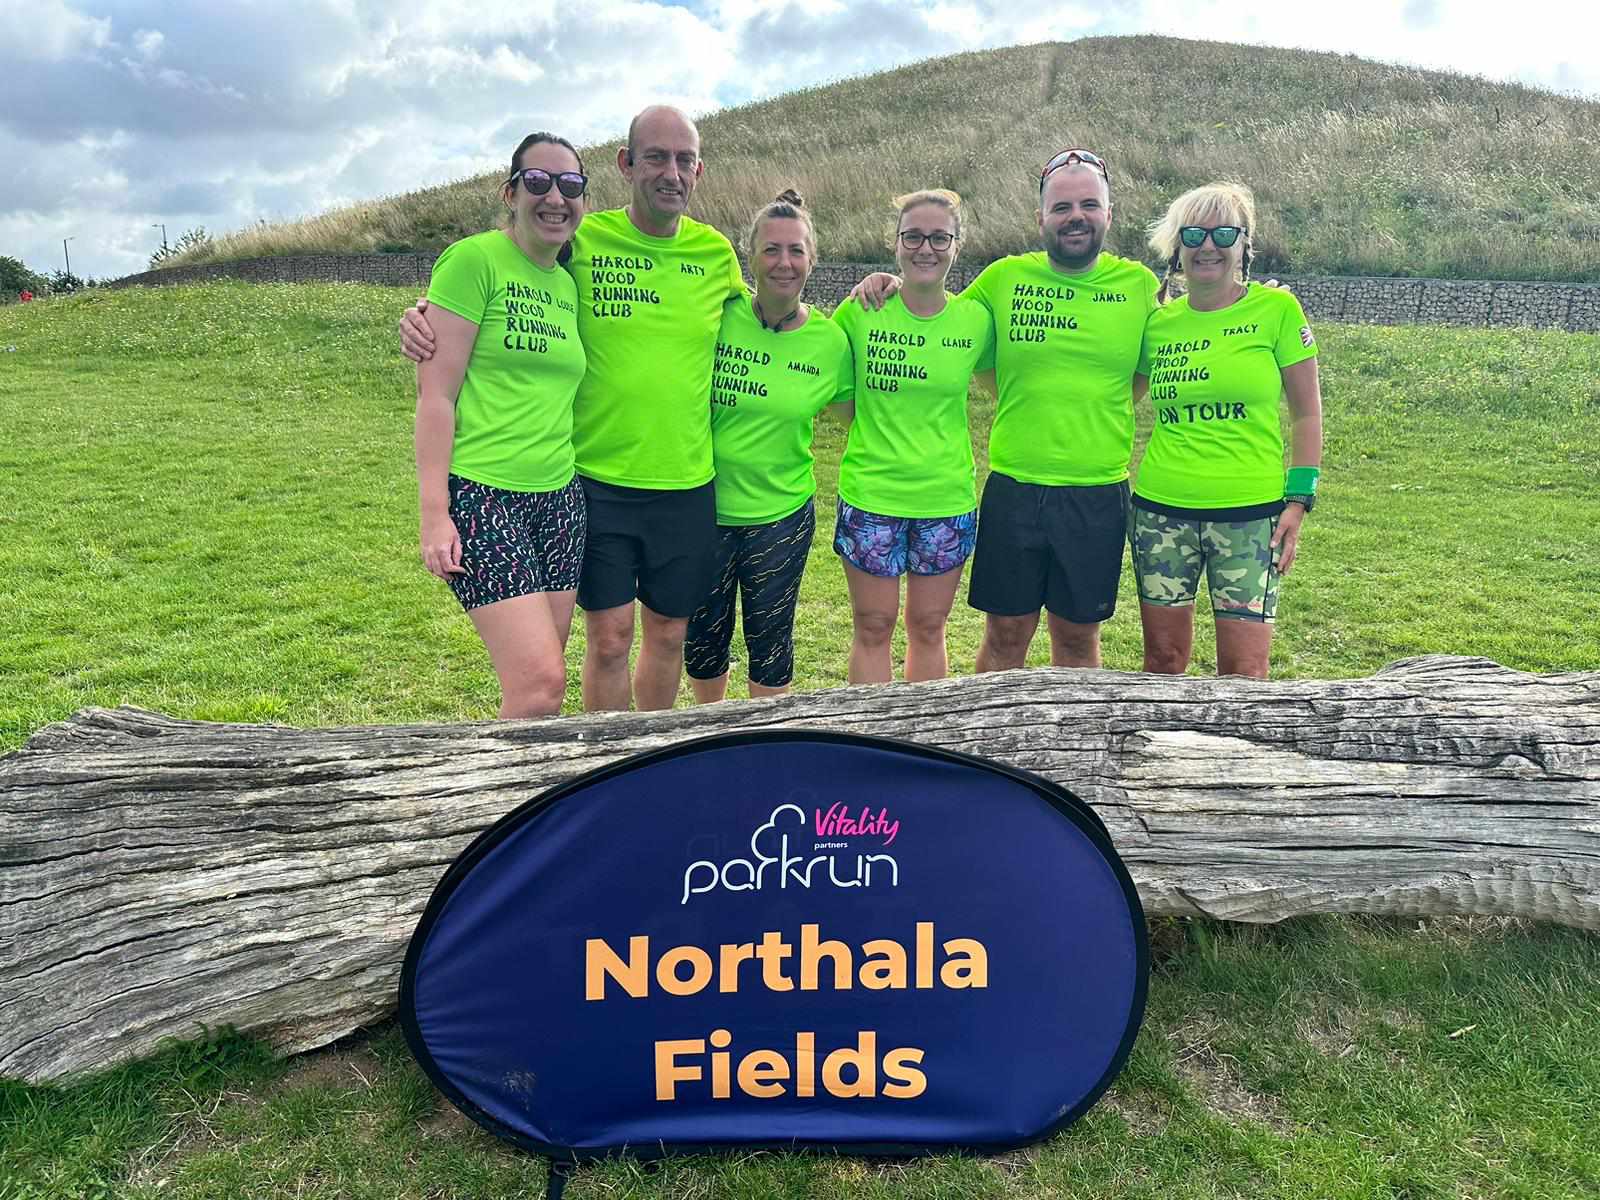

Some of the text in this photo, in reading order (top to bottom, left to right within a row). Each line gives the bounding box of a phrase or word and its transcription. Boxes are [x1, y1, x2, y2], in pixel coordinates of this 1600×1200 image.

[591, 255, 653, 270] HAROLD
[680, 263, 705, 276] ARTY
[591, 270, 635, 284] WOOD
[506, 281, 552, 305] HAROLD
[591, 287, 660, 304] RUNNING
[1014, 284, 1075, 300] HAROLD
[1092, 293, 1127, 302] JAMES
[505, 299, 545, 318] WOOD
[592, 303, 632, 318] CLUB
[1011, 298, 1054, 312] WOOD
[505, 316, 567, 340] RUNNING
[1010, 313, 1078, 329] RUNNING
[868, 329, 926, 347] HAROLD
[1009, 328, 1046, 342] CLUB
[1223, 324, 1258, 336] TRACY
[503, 334, 548, 353] CLUB
[942, 337, 972, 348] CLAIRE
[1157, 339, 1211, 357] HAROLD
[715, 342, 771, 366] HAROLD
[866, 344, 906, 361] WOOD
[713, 359, 749, 376] WOOD
[787, 361, 820, 377] AMANDA
[866, 360, 928, 379] RUNNING
[865, 375, 899, 392] CLUB
[712, 390, 737, 408] LUB
[1160, 402, 1248, 425] ON TOUR
[814, 801, 899, 846] Vitality
[814, 841, 848, 851] partners
[681, 820, 898, 904] parkrun
[586, 922, 988, 1001] Northala
[655, 1029, 928, 1101] Fields
